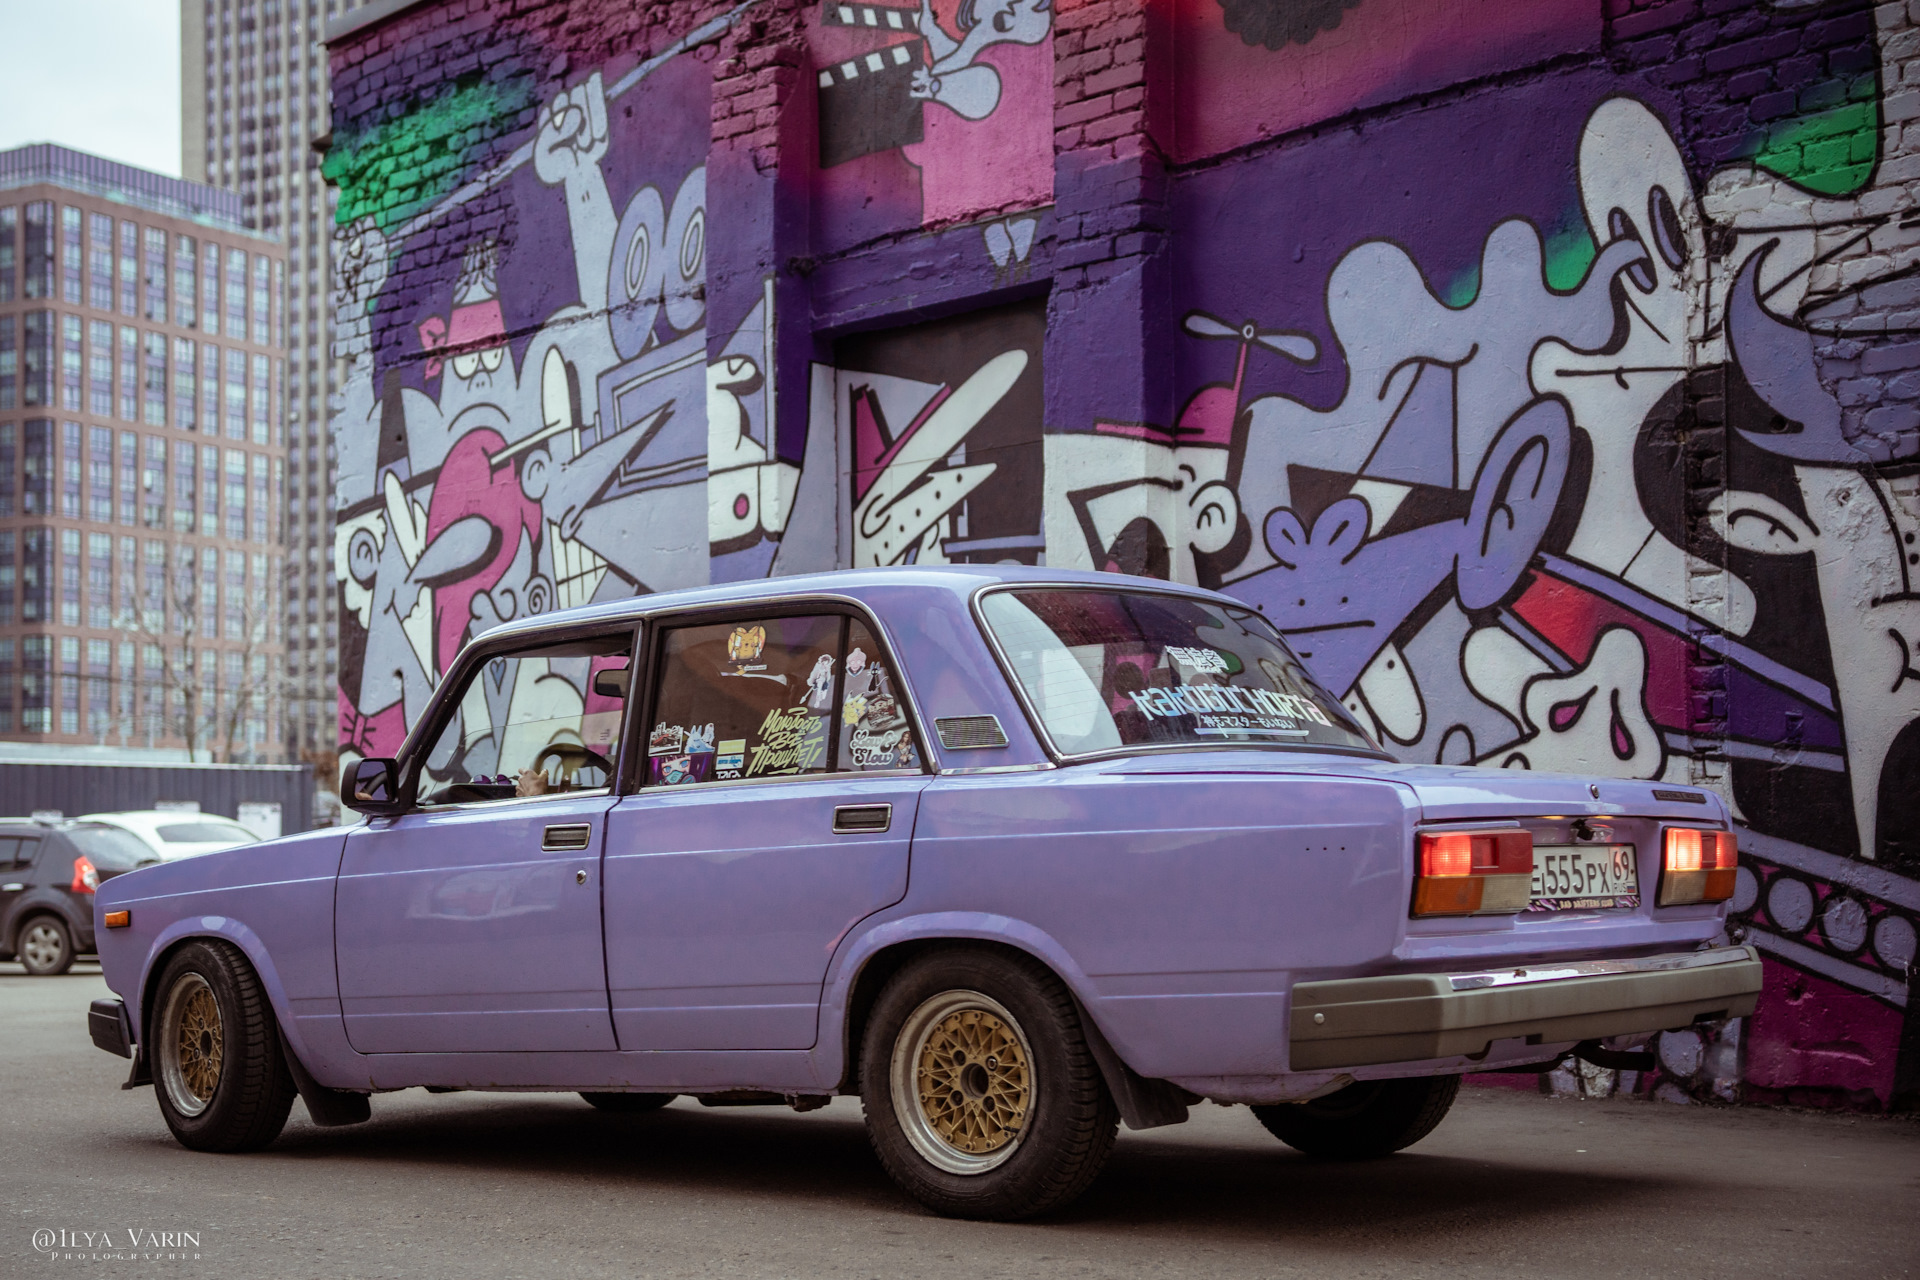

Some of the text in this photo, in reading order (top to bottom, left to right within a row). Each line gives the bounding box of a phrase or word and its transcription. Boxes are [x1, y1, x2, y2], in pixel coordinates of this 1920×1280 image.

[850, 729, 881, 748] Low
[851, 747, 893, 766] Slow
[1613, 851, 1629, 881] 69
[1614, 882, 1627, 893] RUS
